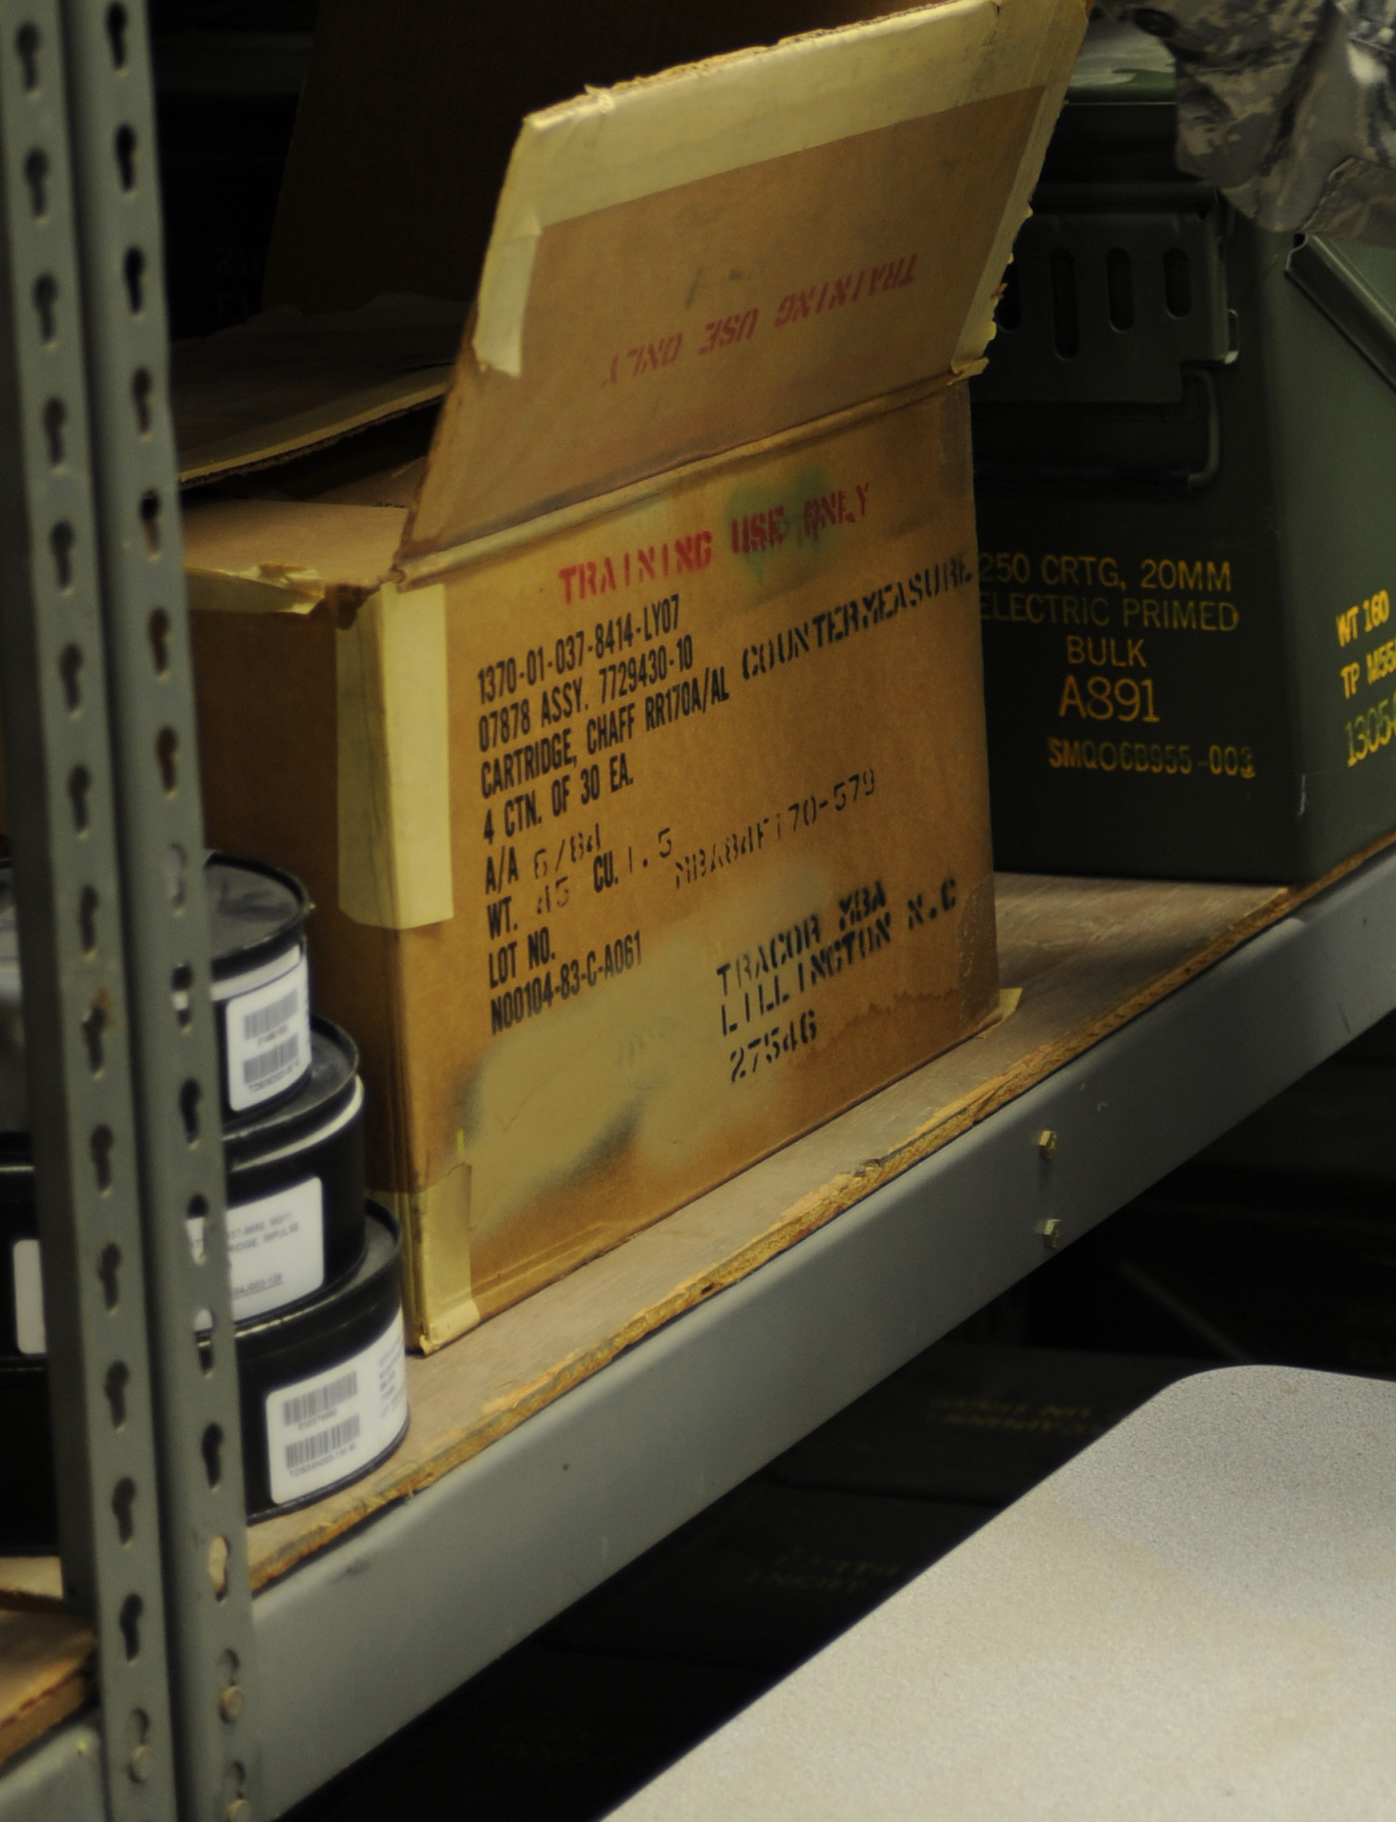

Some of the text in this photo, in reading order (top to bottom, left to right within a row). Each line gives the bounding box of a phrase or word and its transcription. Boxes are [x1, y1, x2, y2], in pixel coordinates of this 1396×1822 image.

[600, 253, 917, 388] TRAINING USE ONLY
[558, 482, 869, 605] TRAINING USE ONLY
[978, 552, 1233, 593] 250 CRTG, 20MM
[477, 593, 680, 705] 1370-01-037-8414-LY07
[980, 590, 1240, 632] ELECTRIC PRIMED
[1066, 634, 1148, 669] BULK
[1336, 605, 1359, 648] WT
[479, 634, 693, 752] 07878 ASSY. 7729430-10
[481, 554, 973, 799] CARTRIDGE, CHAFF RR170A/AL COUNTERMEASURE
[1058, 674, 1161, 723] A891
[1340, 662, 1361, 700] TP
[483, 752, 634, 846] 4 CTN. OF 30 EA.
[486, 845, 519, 895] A/A
[487, 895, 518, 941] WT.
[592, 851, 619, 894] CU.
[488, 941, 518, 990] LOT
[528, 926, 556, 971] NO.
[716, 878, 887, 997] TRACOR MBA
[720, 911, 892, 1036] LILLINGTON
[490, 930, 643, 1036] N00104-83-C-A061
[729, 1009, 817, 1083] 27546
